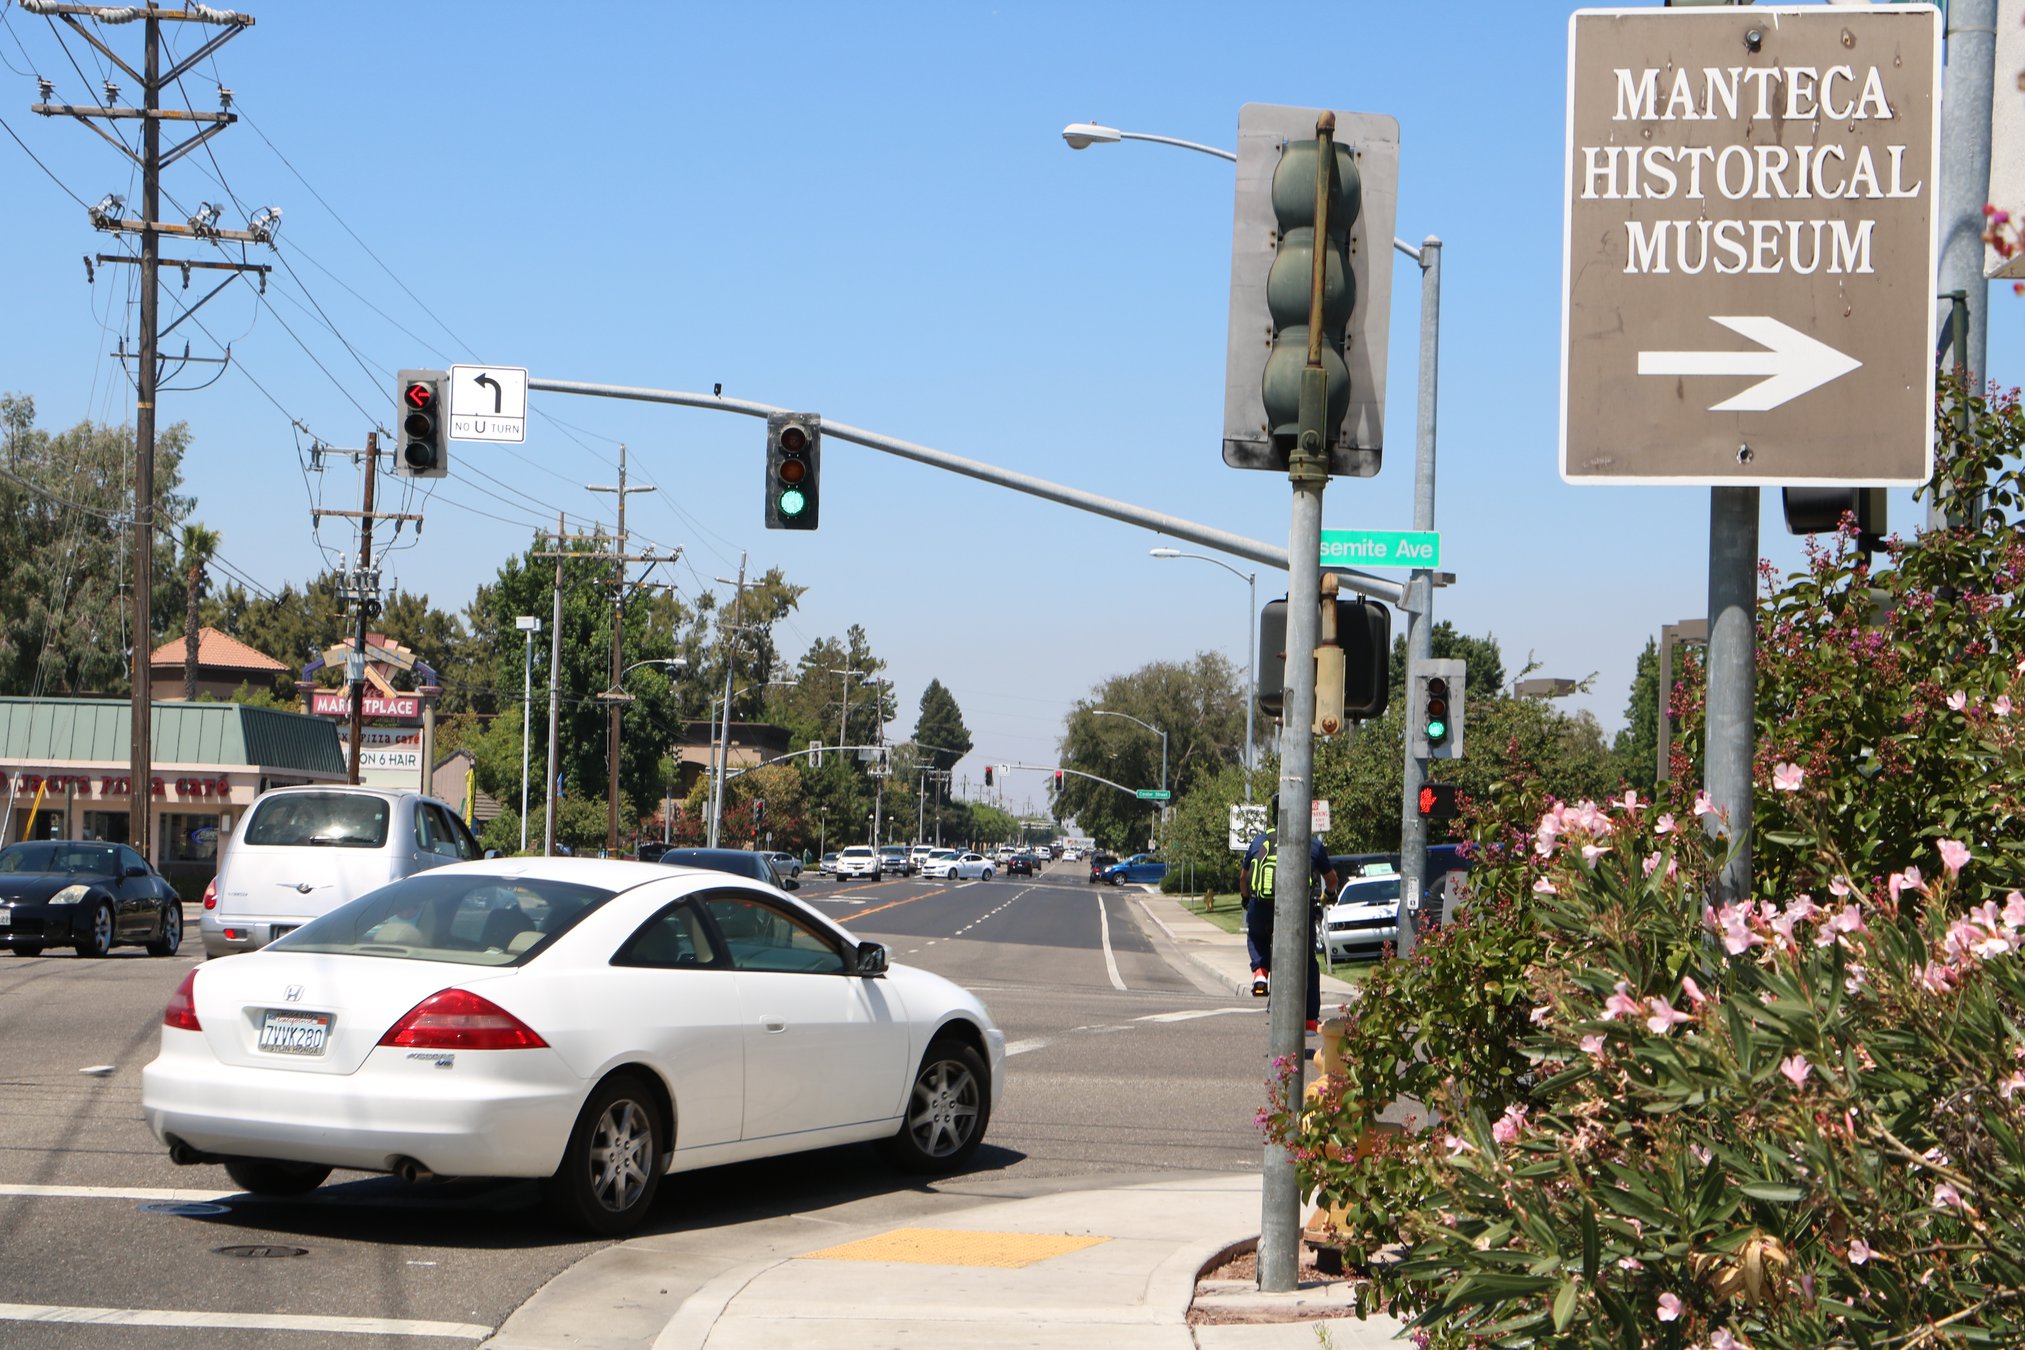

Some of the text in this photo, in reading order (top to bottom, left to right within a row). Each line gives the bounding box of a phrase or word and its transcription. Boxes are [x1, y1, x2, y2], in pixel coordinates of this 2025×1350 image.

[1612, 65, 1894, 121] MANTECA
[1580, 144, 1922, 200] HISTORICAL
[1623, 219, 1875, 275] MUSEUM
[455, 421, 520, 434] NO U TURN
[1320, 538, 1433, 558] semite Ave
[317, 698, 413, 715] MARTPLACE
[389, 754, 416, 766] HAIR
[266, 1025, 322, 1048] 7VVK280
